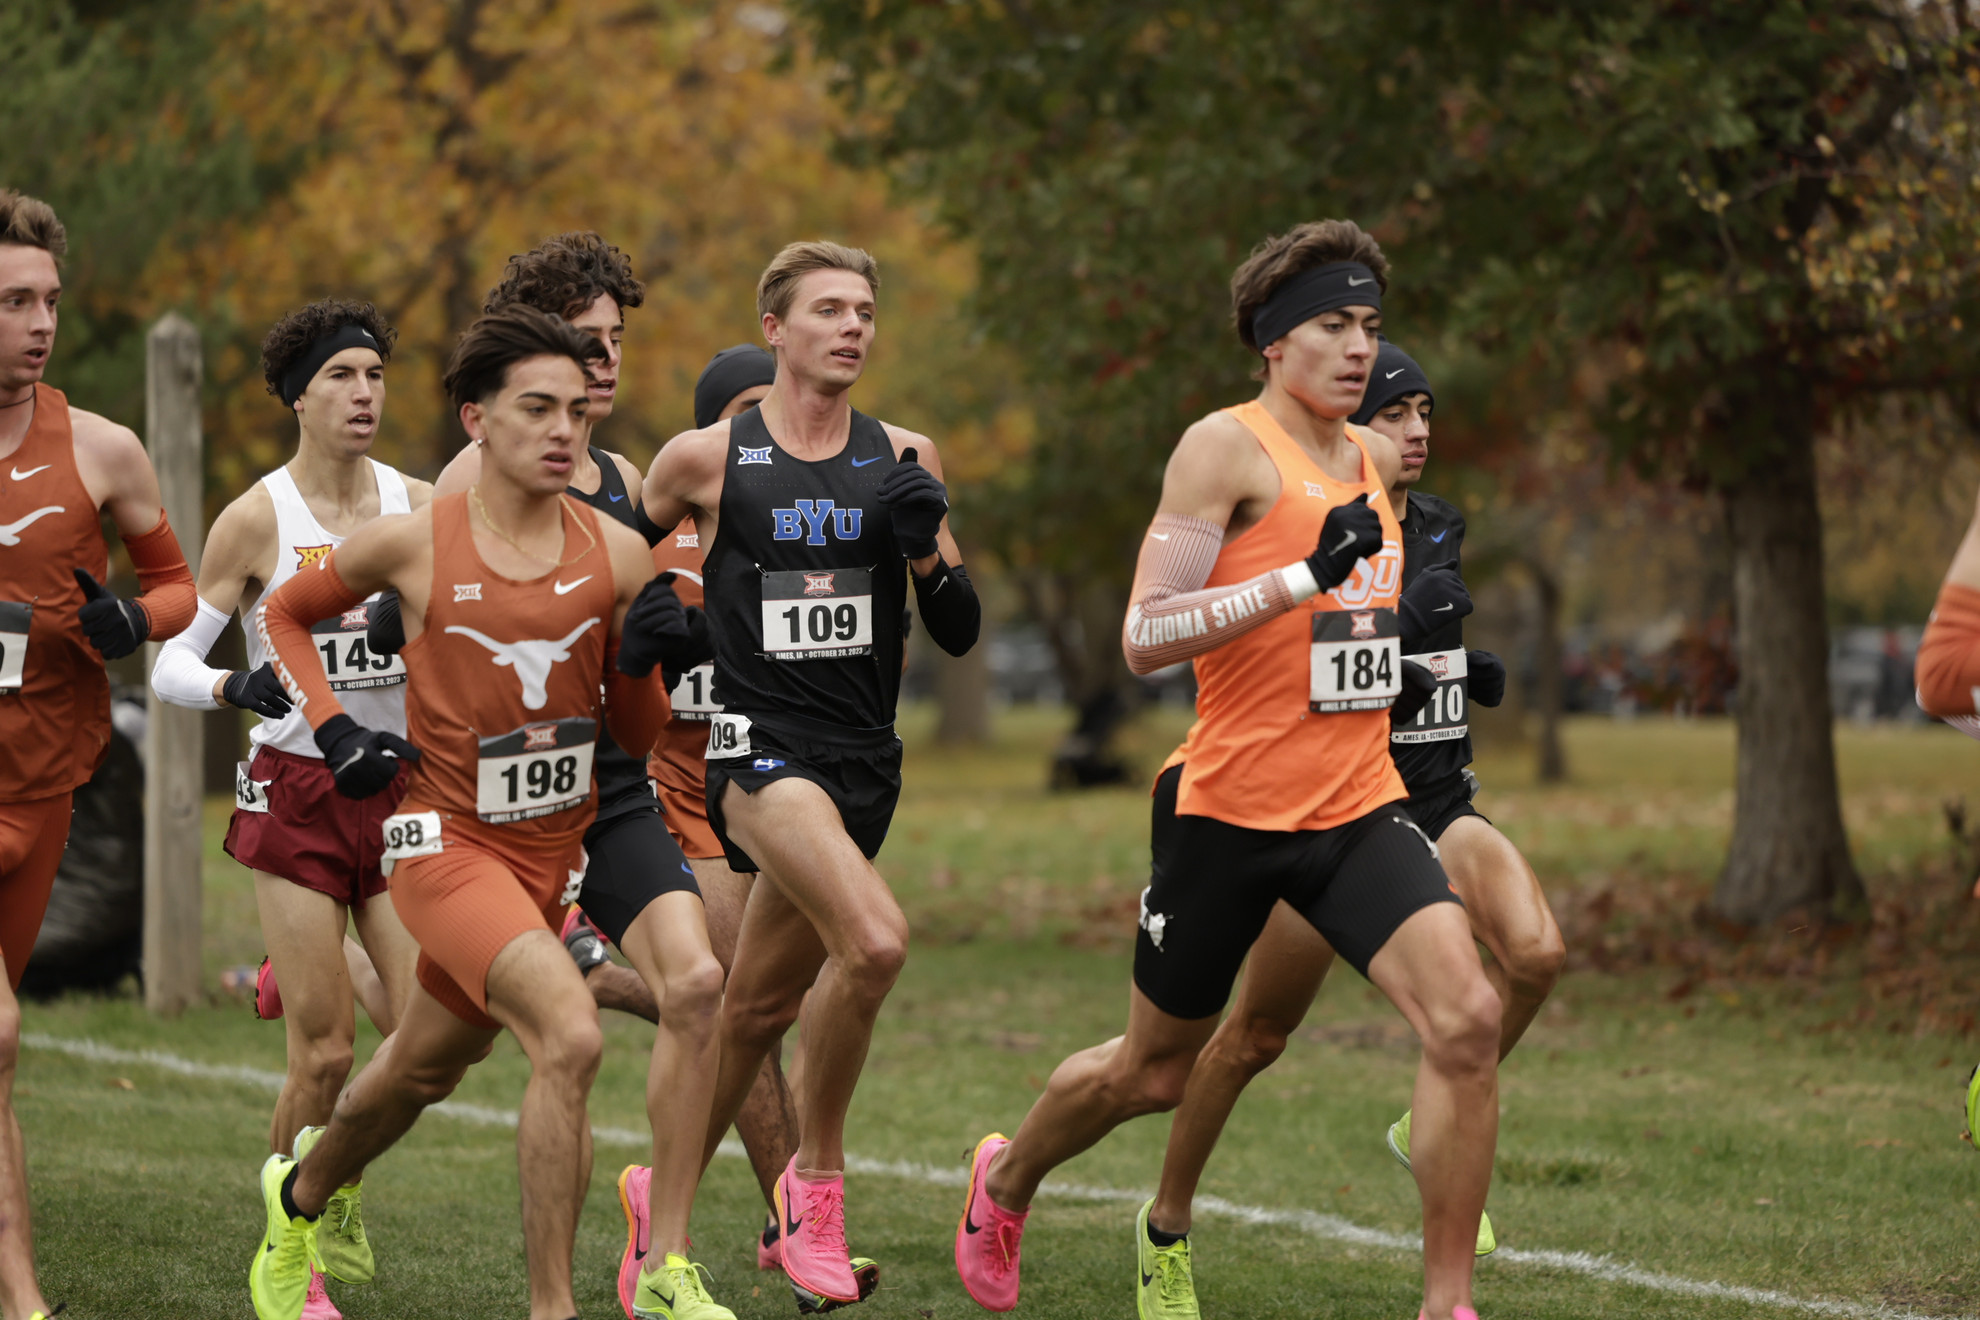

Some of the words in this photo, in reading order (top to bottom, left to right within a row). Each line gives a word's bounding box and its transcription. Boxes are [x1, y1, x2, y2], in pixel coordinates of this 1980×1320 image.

[772, 499, 863, 545] BYU
[782, 603, 857, 643] 109
[1211, 584, 1270, 628] STATE
[776, 652, 796, 660] AMES,
[808, 649, 837, 659] OCTOBER
[848, 647, 863, 656] 2023
[1331, 647, 1392, 691] 184
[346, 679, 375, 689] OCTOBER
[708, 722, 738, 751] 09
[501, 756, 577, 804] 198
